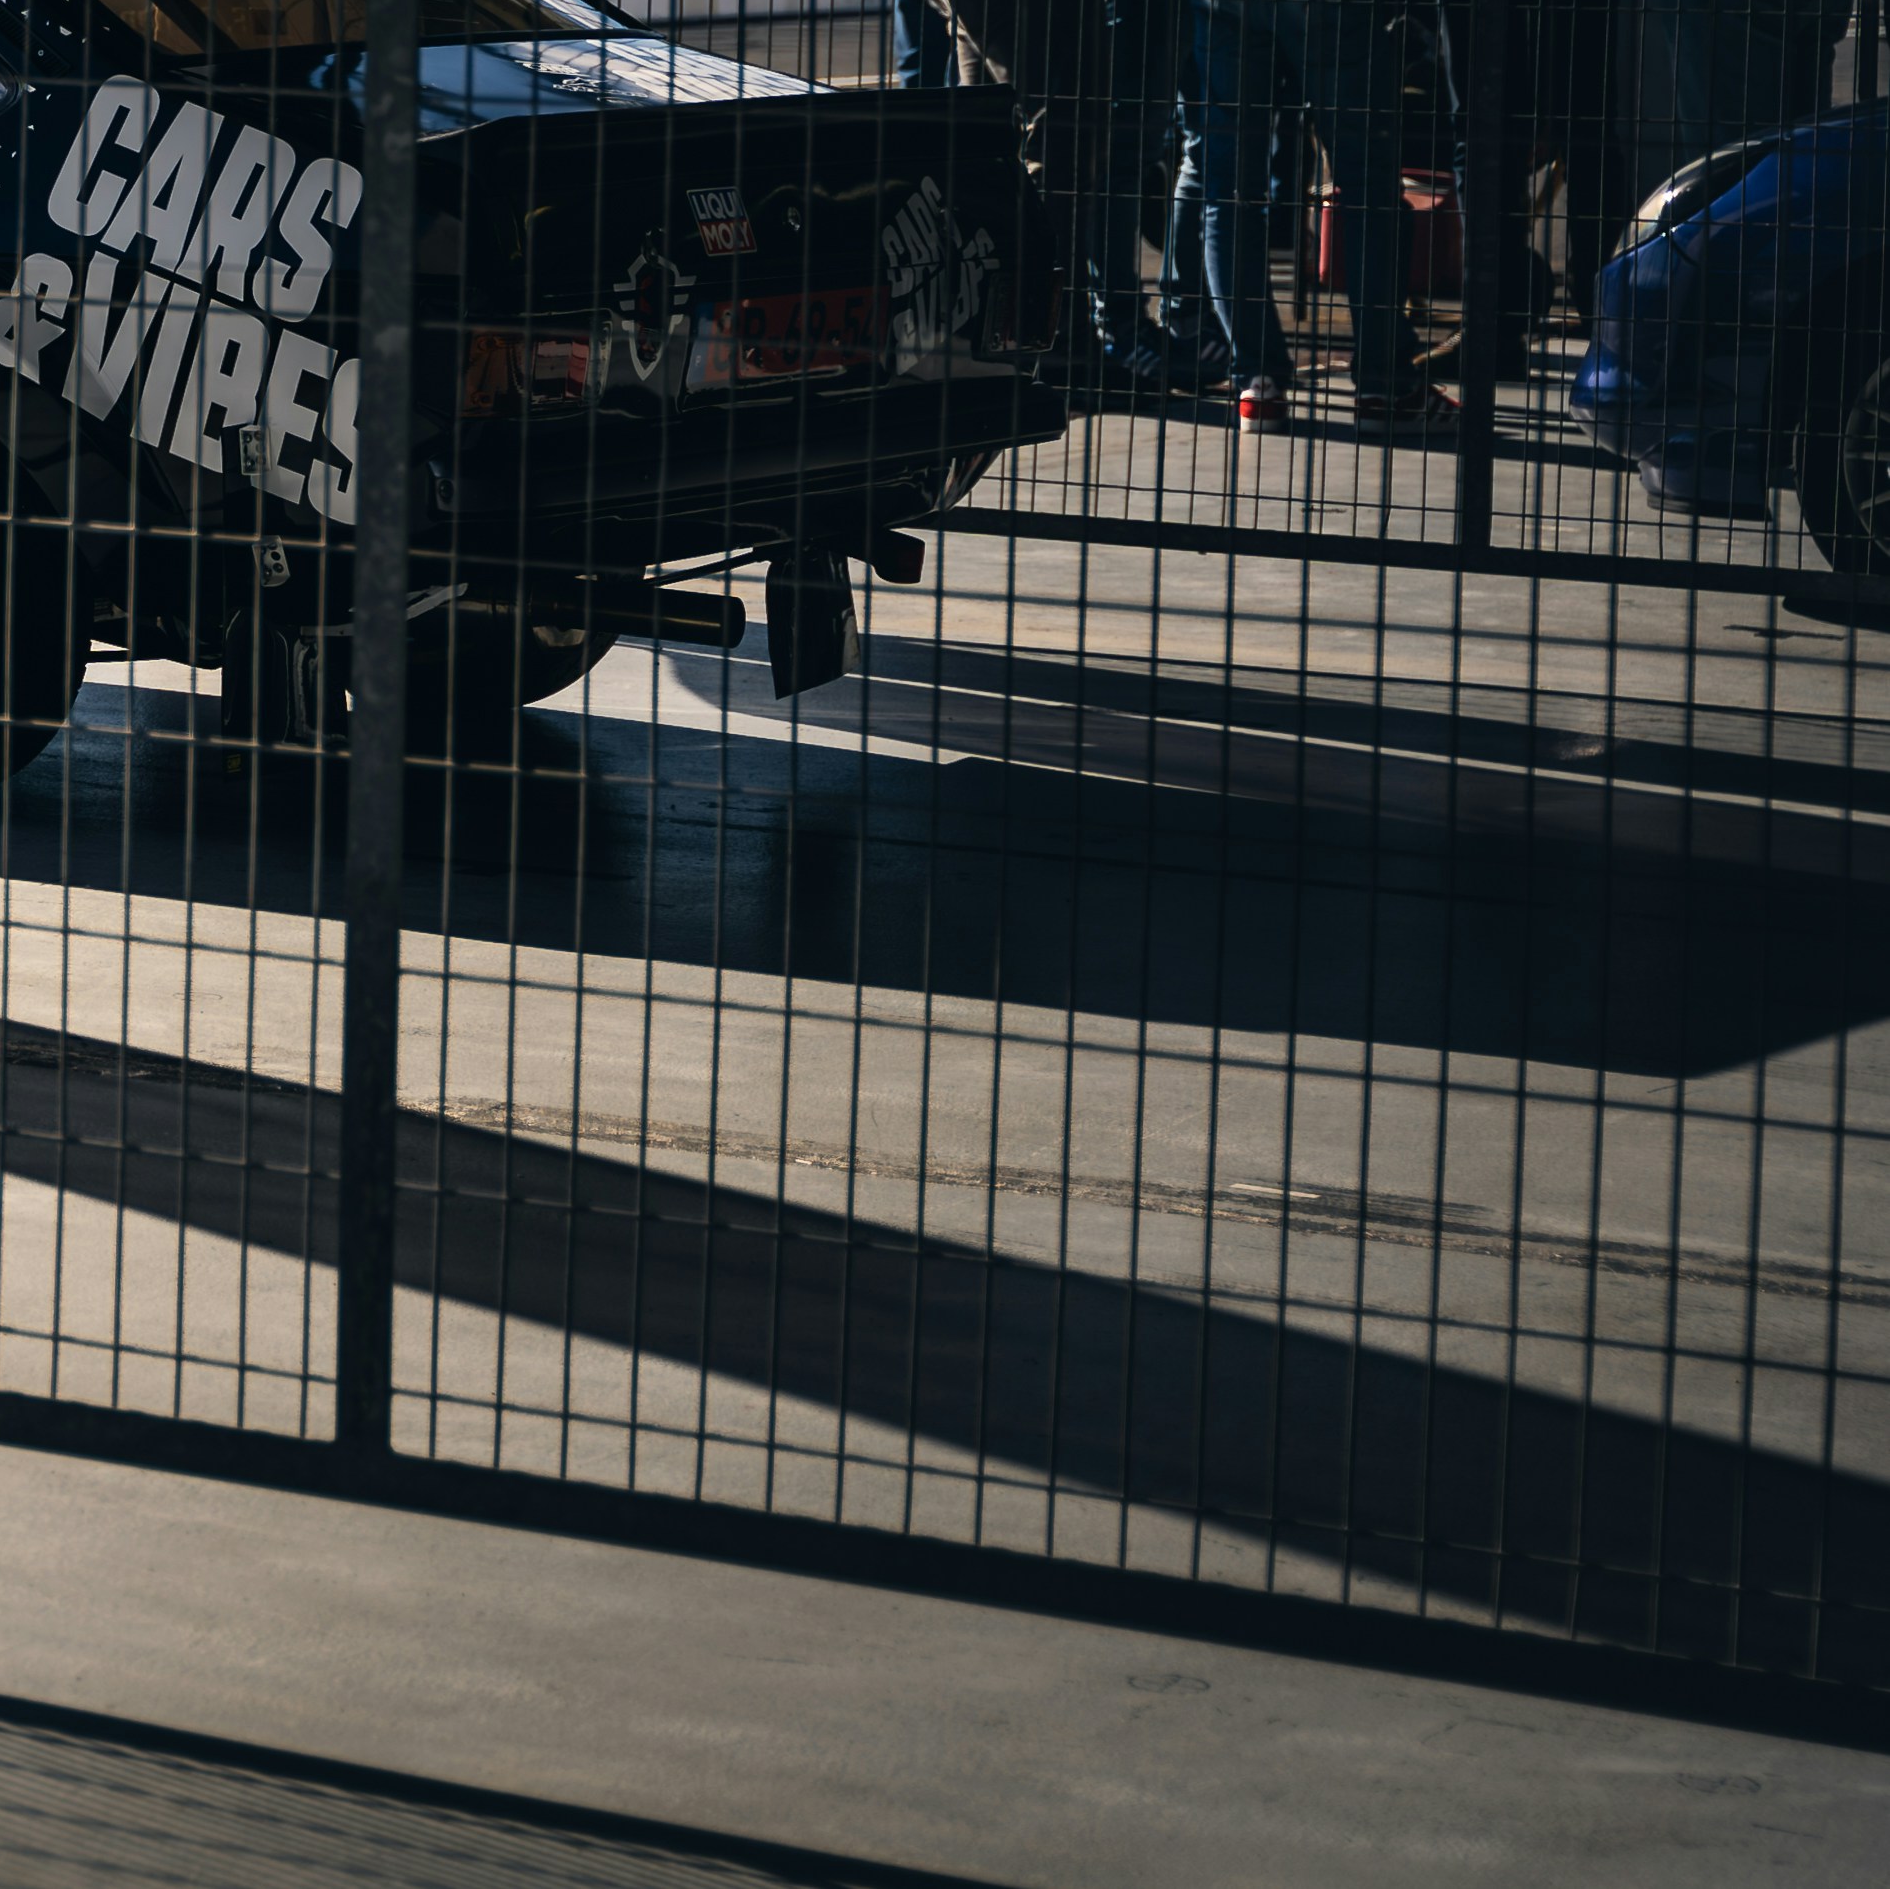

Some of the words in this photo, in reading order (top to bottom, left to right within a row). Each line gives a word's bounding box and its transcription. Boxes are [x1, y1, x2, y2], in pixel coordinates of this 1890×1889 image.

[48, 74, 363, 323] CARS
[691, 189, 746, 220] LIQUI
[702, 221, 752, 250] MOLY
